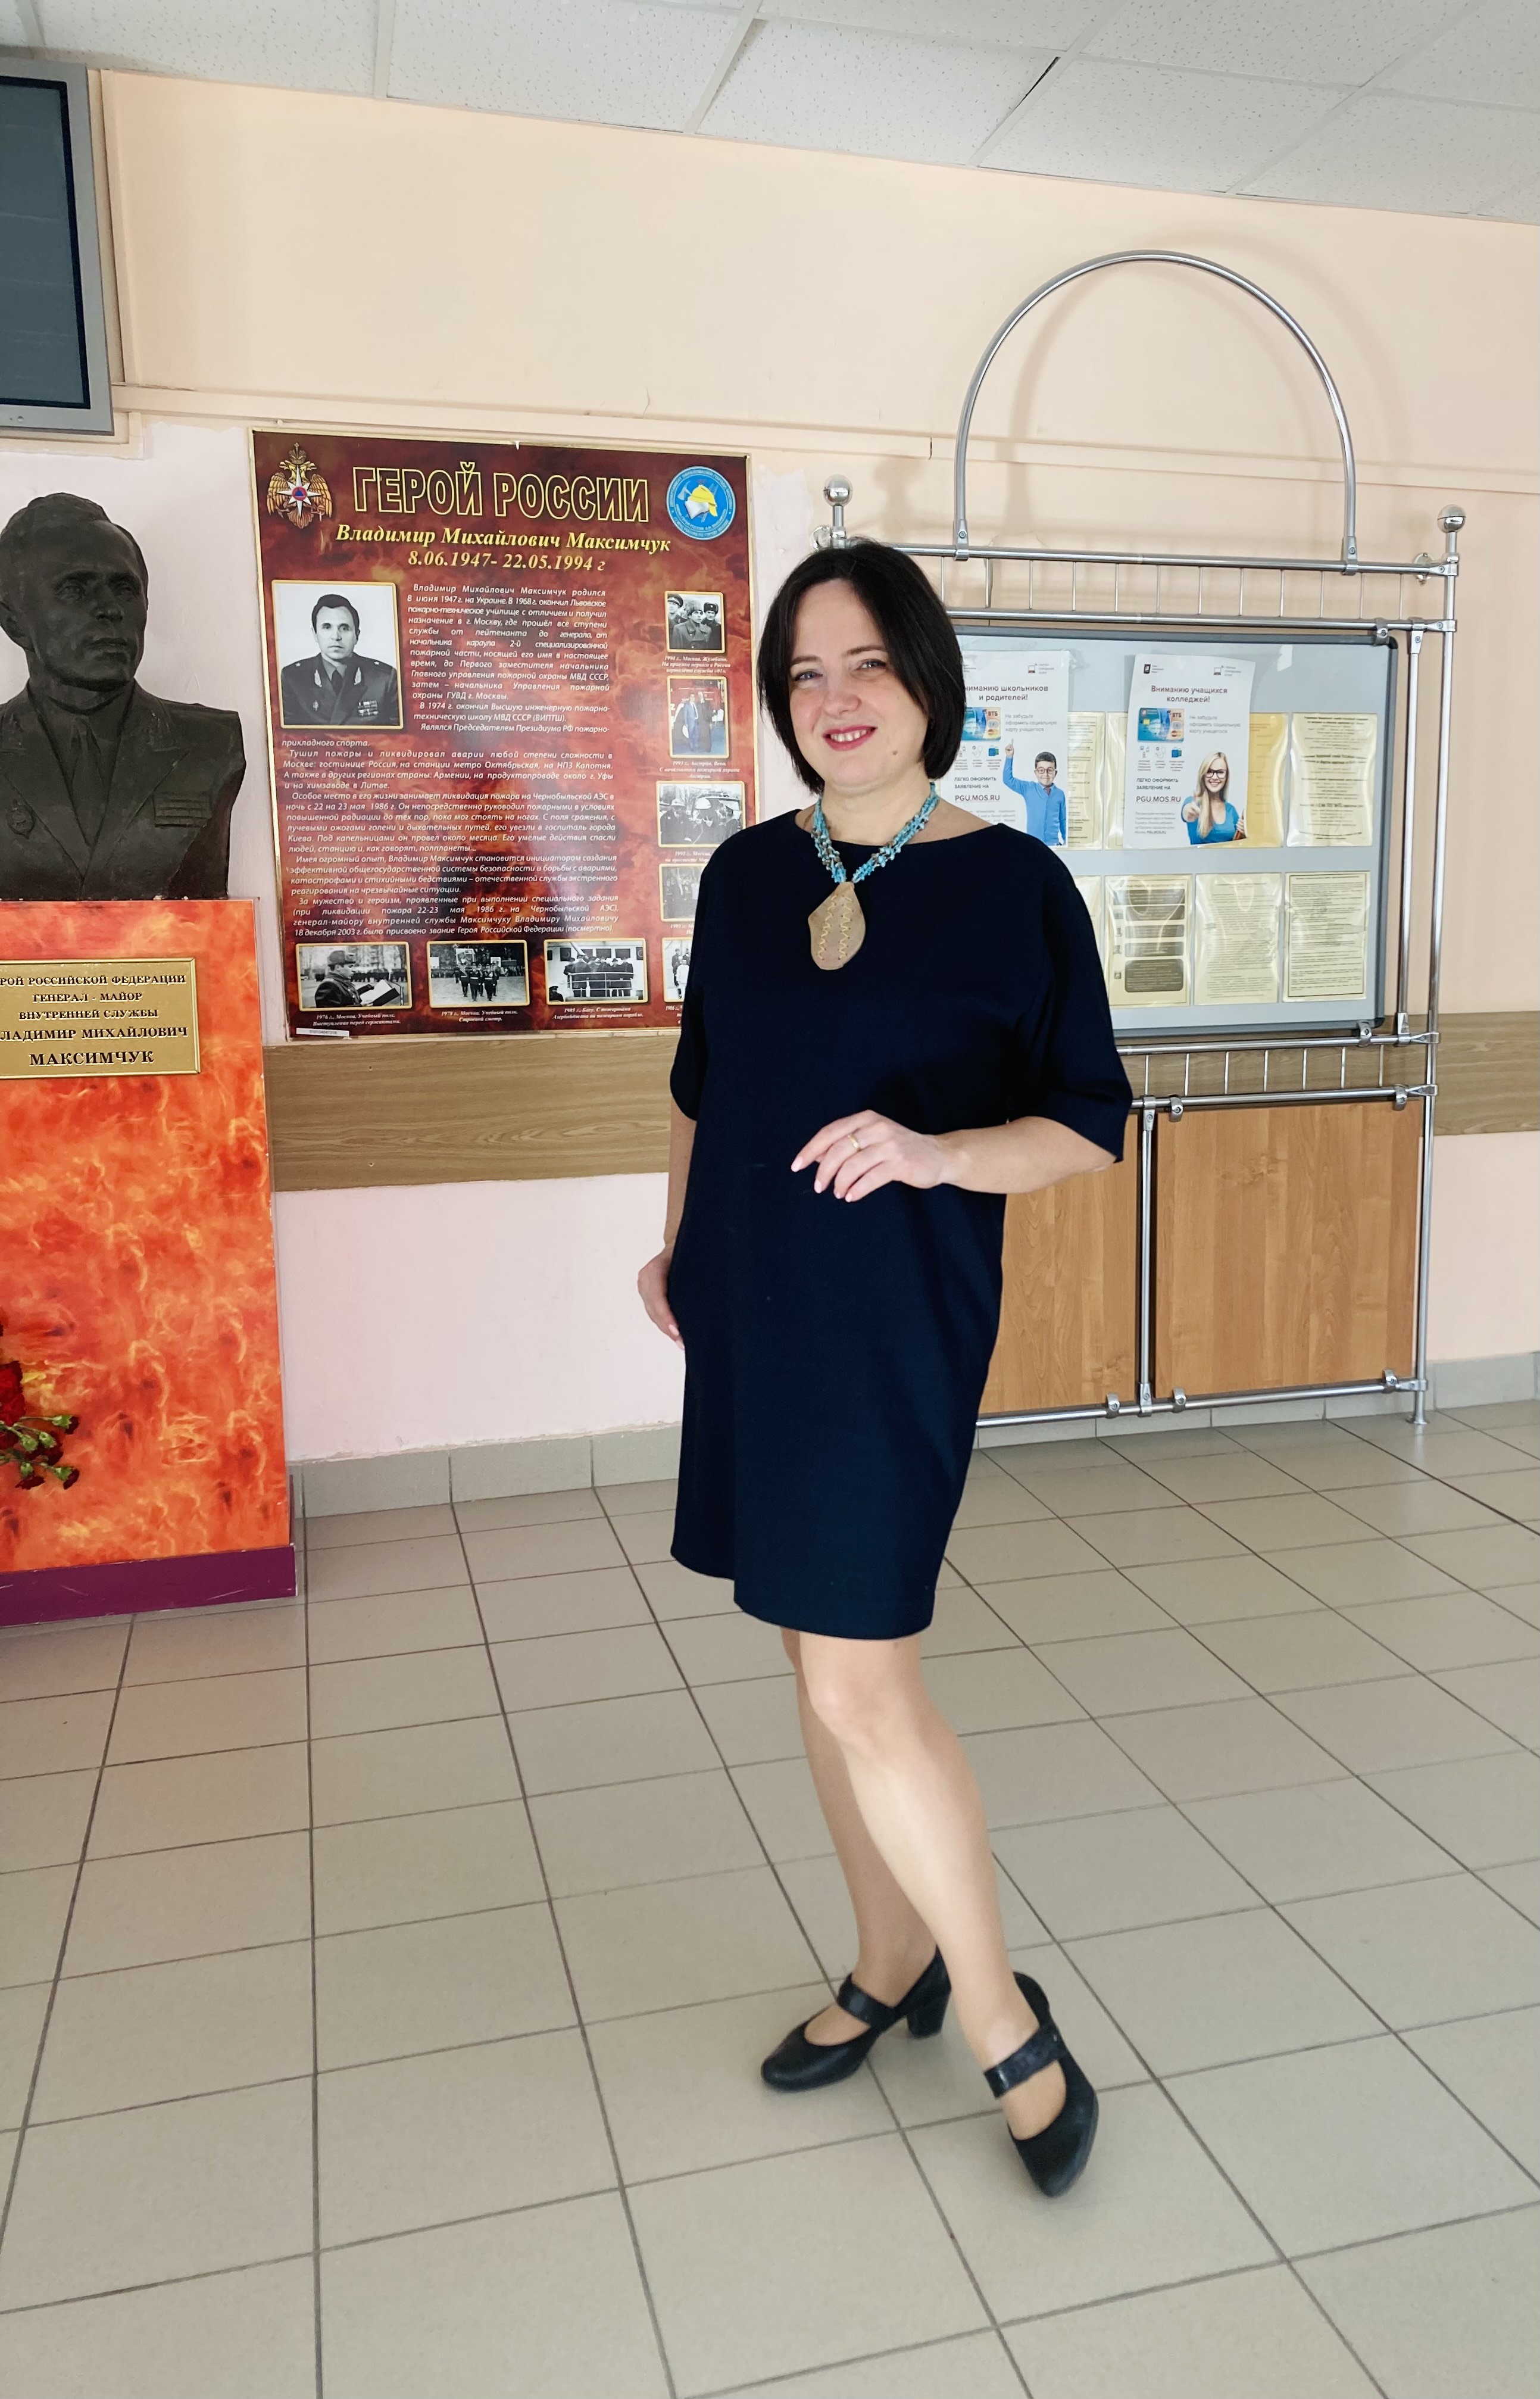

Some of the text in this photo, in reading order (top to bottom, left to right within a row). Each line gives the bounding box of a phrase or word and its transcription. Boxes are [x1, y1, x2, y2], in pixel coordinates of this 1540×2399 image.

[353, 461, 482, 516] ГЕРОЙ
[494, 472, 649, 522] РОССИИ
[336, 524, 671, 554] Владимир Михайлович Максимчук
[408, 550, 606, 570] 8.06.1947- 22.05.1994 г
[413, 584, 605, 597] Владимир Михайлович Максимчук родился
[408, 626, 439, 635] службы
[475, 628, 527, 637] лейтенанта
[460, 660, 492, 668] Первого
[411, 669, 446, 678] Главного
[497, 672, 536, 680] пожарной
[569, 672, 587, 681] МВД
[589, 673, 609, 681] СССР,
[513, 682, 560, 691] Управления
[570, 684, 610, 692] пожарной
[446, 691, 466, 700] ГУВД
[986, 694, 1028, 702] родителей!
[491, 703, 523, 712] Высшую
[493, 713, 511, 722] МВД
[533, 714, 567, 722] (ВИПТШ).
[453, 723, 514, 732] Председателем
[516, 724, 561, 733] Президиума
[282, 738, 335, 747] прикладного
[289, 749, 318, 759] Тушил
[379, 750, 445, 759] ликвидировал
[388, 854, 428, 863] Владимир
[429, 854, 473, 863] Максимчук
[290, 888, 348, 896] реагирования
[293, 915, 619, 926] генерал-майору внутренней службы Максимчуку Владимиру Михайловичу
[0, 975, 186, 987] РОЙ РОССИЙСКОЙ ФЕДЕРАЦИИ
[32, 993, 89, 1003] ГЕНЕРАЛ
[99, 991, 142, 1002] МАЙОР
[18, 1009, 158, 1020] ВНУТРЕННЕЙ СЛУЖБЫ
[0, 1025, 188, 1043] ЛАДИМИР МИХАЙЛОВИЧ
[29, 1050, 154, 1066] МАКСИМЧУК
